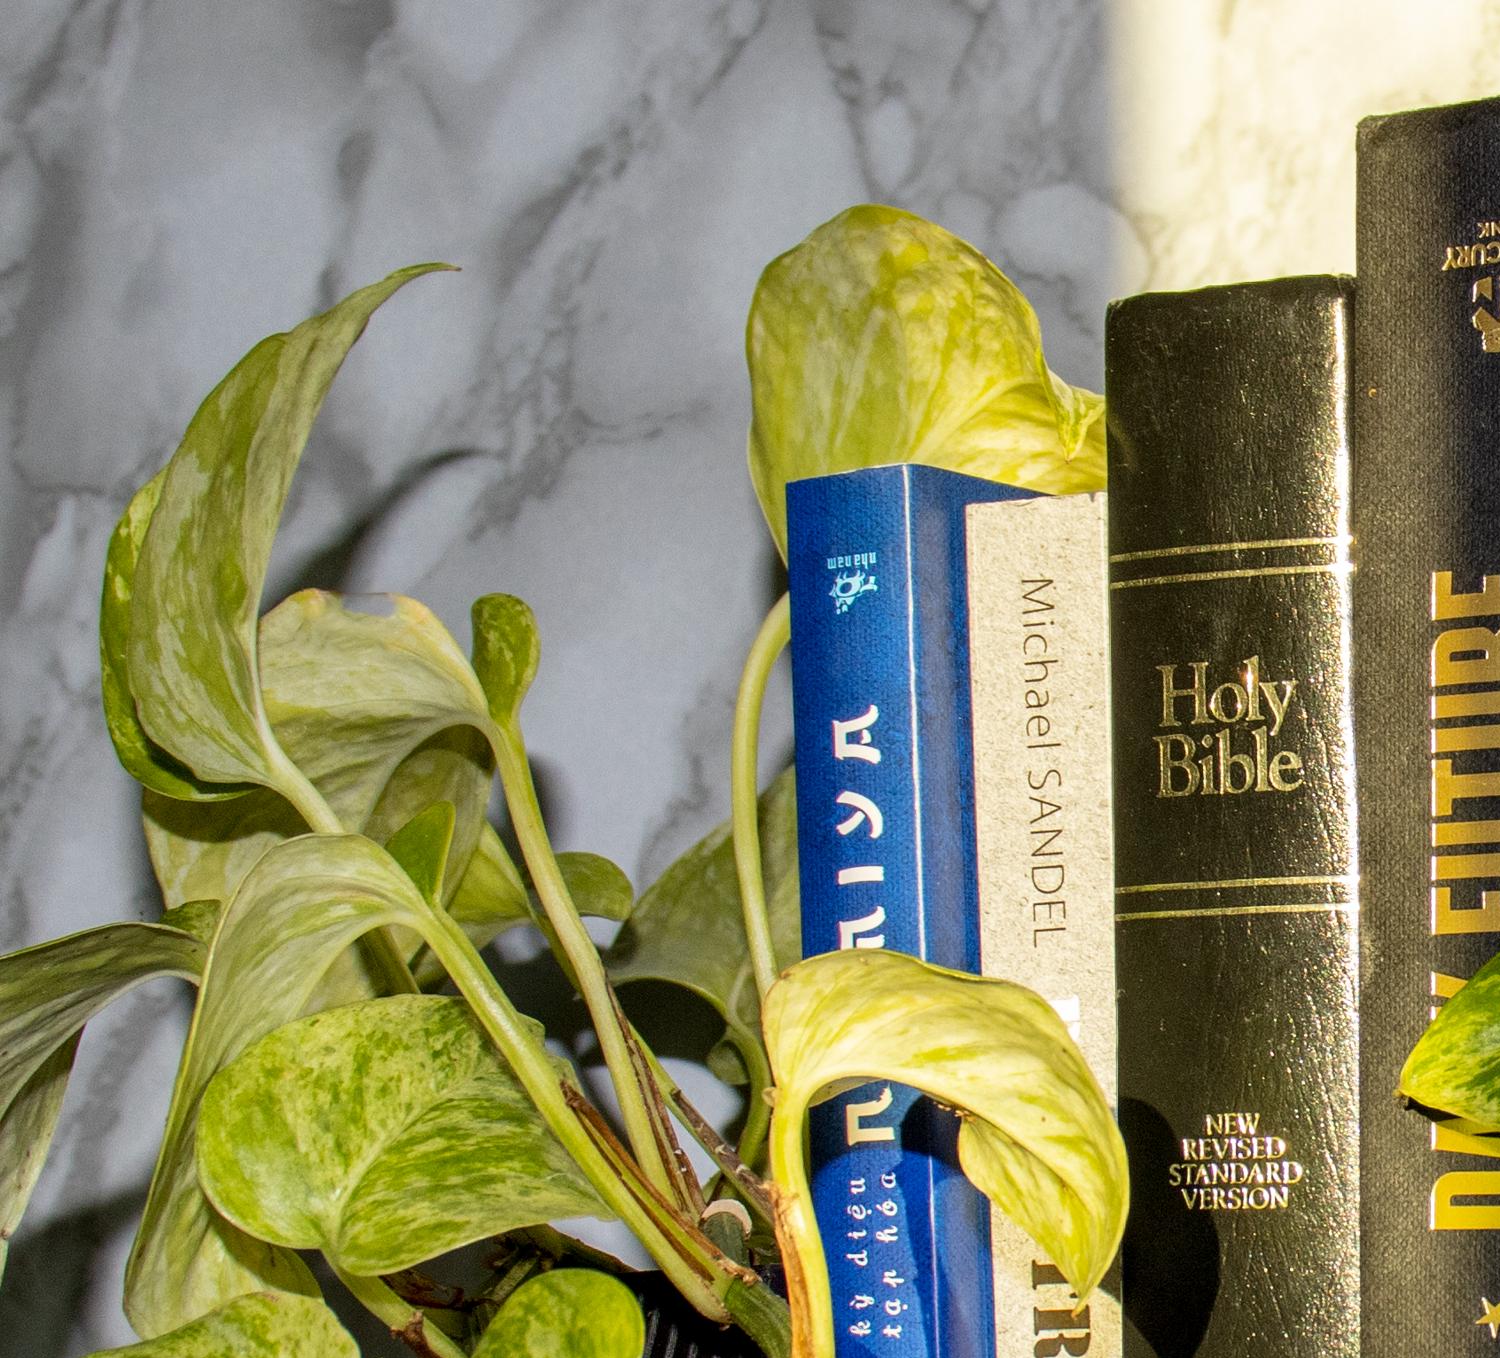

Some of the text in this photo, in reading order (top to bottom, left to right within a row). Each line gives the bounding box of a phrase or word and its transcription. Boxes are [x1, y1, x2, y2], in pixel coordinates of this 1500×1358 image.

[826, 555, 852, 570] nam
[1021, 578, 1061, 749] Michael
[1156, 655, 1298, 736] Holy
[1153, 727, 1304, 798] Bible
[1027, 769, 1067, 947] SANDEL
[1183, 1137, 1286, 1160] REVISED
[1206, 1113, 1260, 1135] NEW
[875, 1172, 899, 1244] hóa
[1169, 1162, 1303, 1186] STANDARD
[1181, 1187, 1289, 1210] VERSION
[845, 1177, 872, 1267] diệu
[848, 1294, 875, 1337] kỳ
[882, 1269, 909, 1339] tạp
